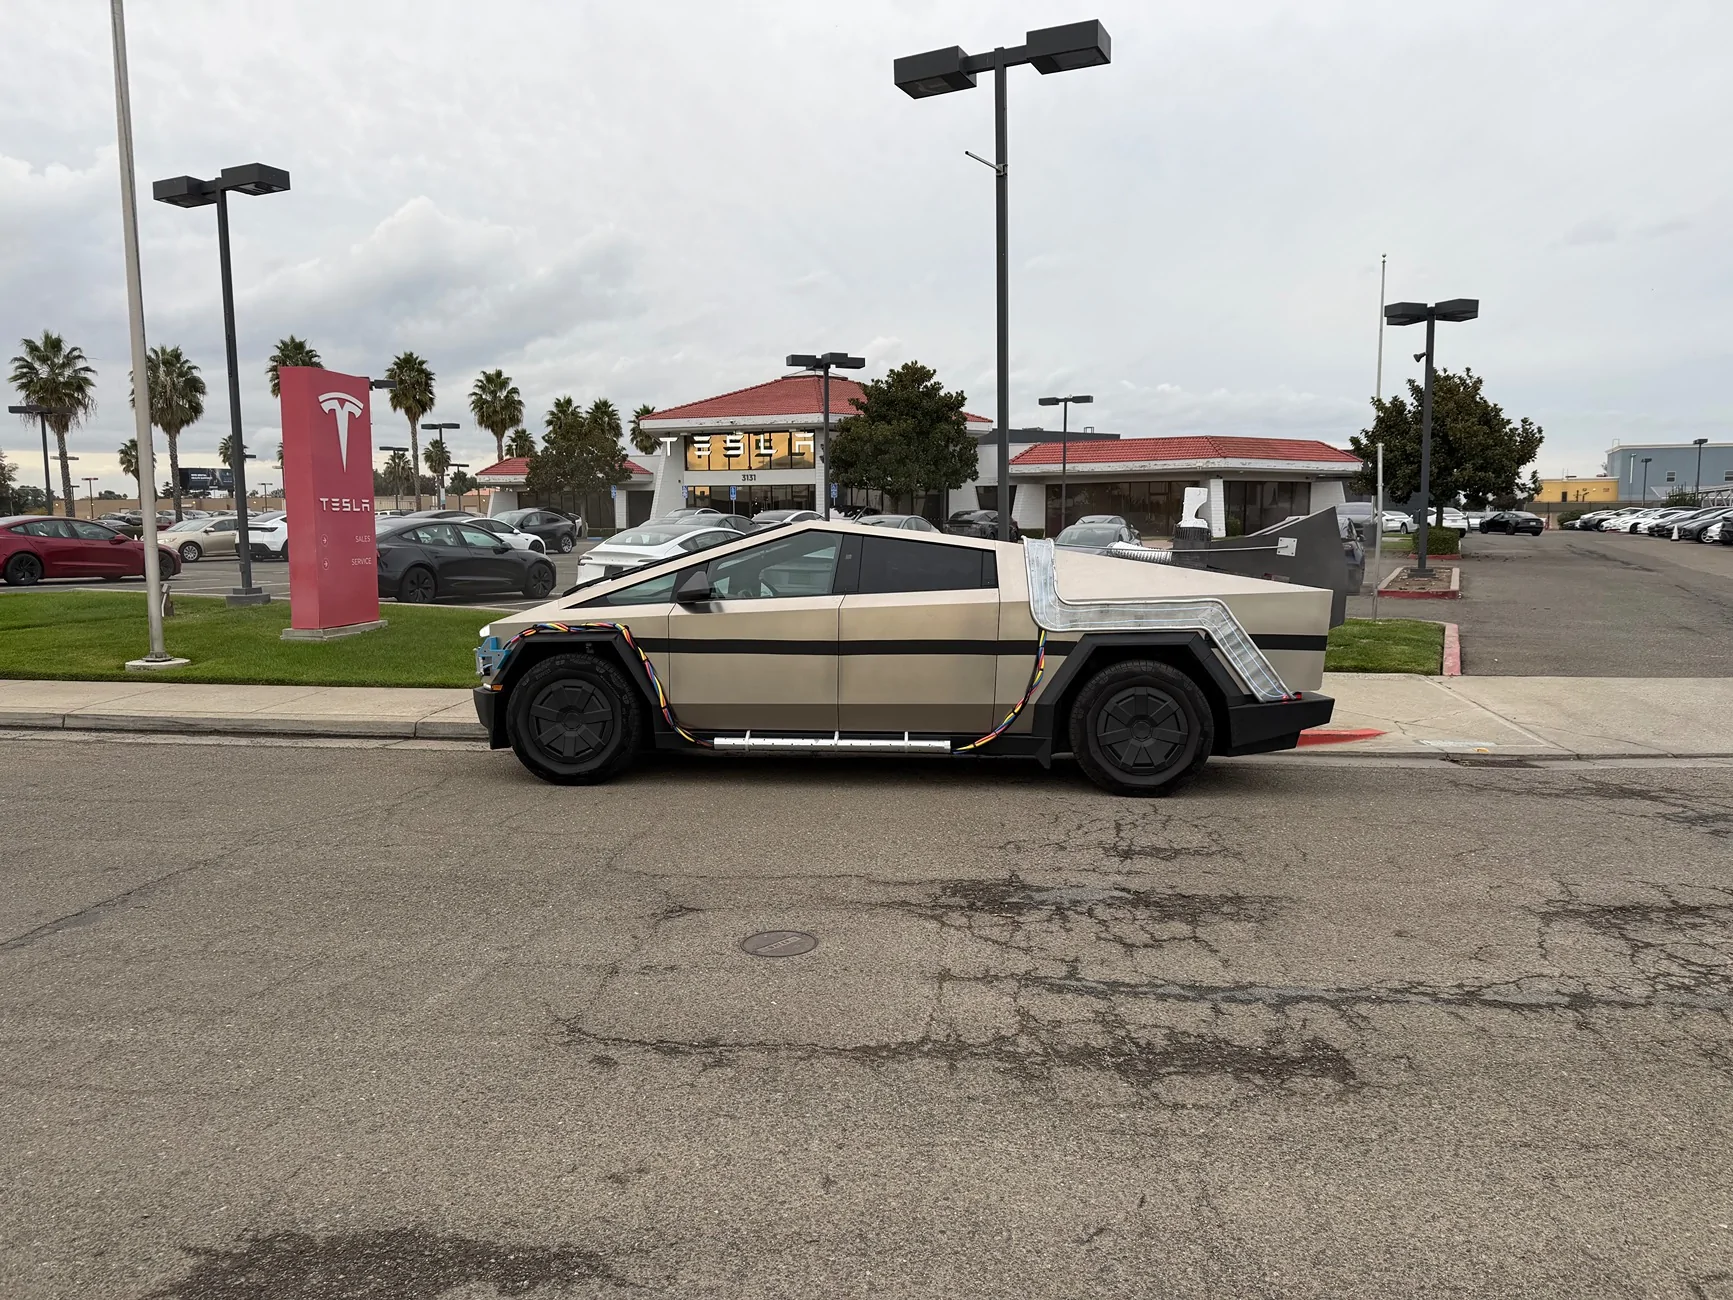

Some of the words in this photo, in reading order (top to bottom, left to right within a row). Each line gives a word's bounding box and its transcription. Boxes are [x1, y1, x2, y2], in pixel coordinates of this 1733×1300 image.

[659, 432, 814, 457] TESLA
[741, 474, 757, 482] 3131
[319, 497, 371, 512] TESLA
[355, 535, 371, 543] SALES
[351, 557, 372, 566] SERVICE
